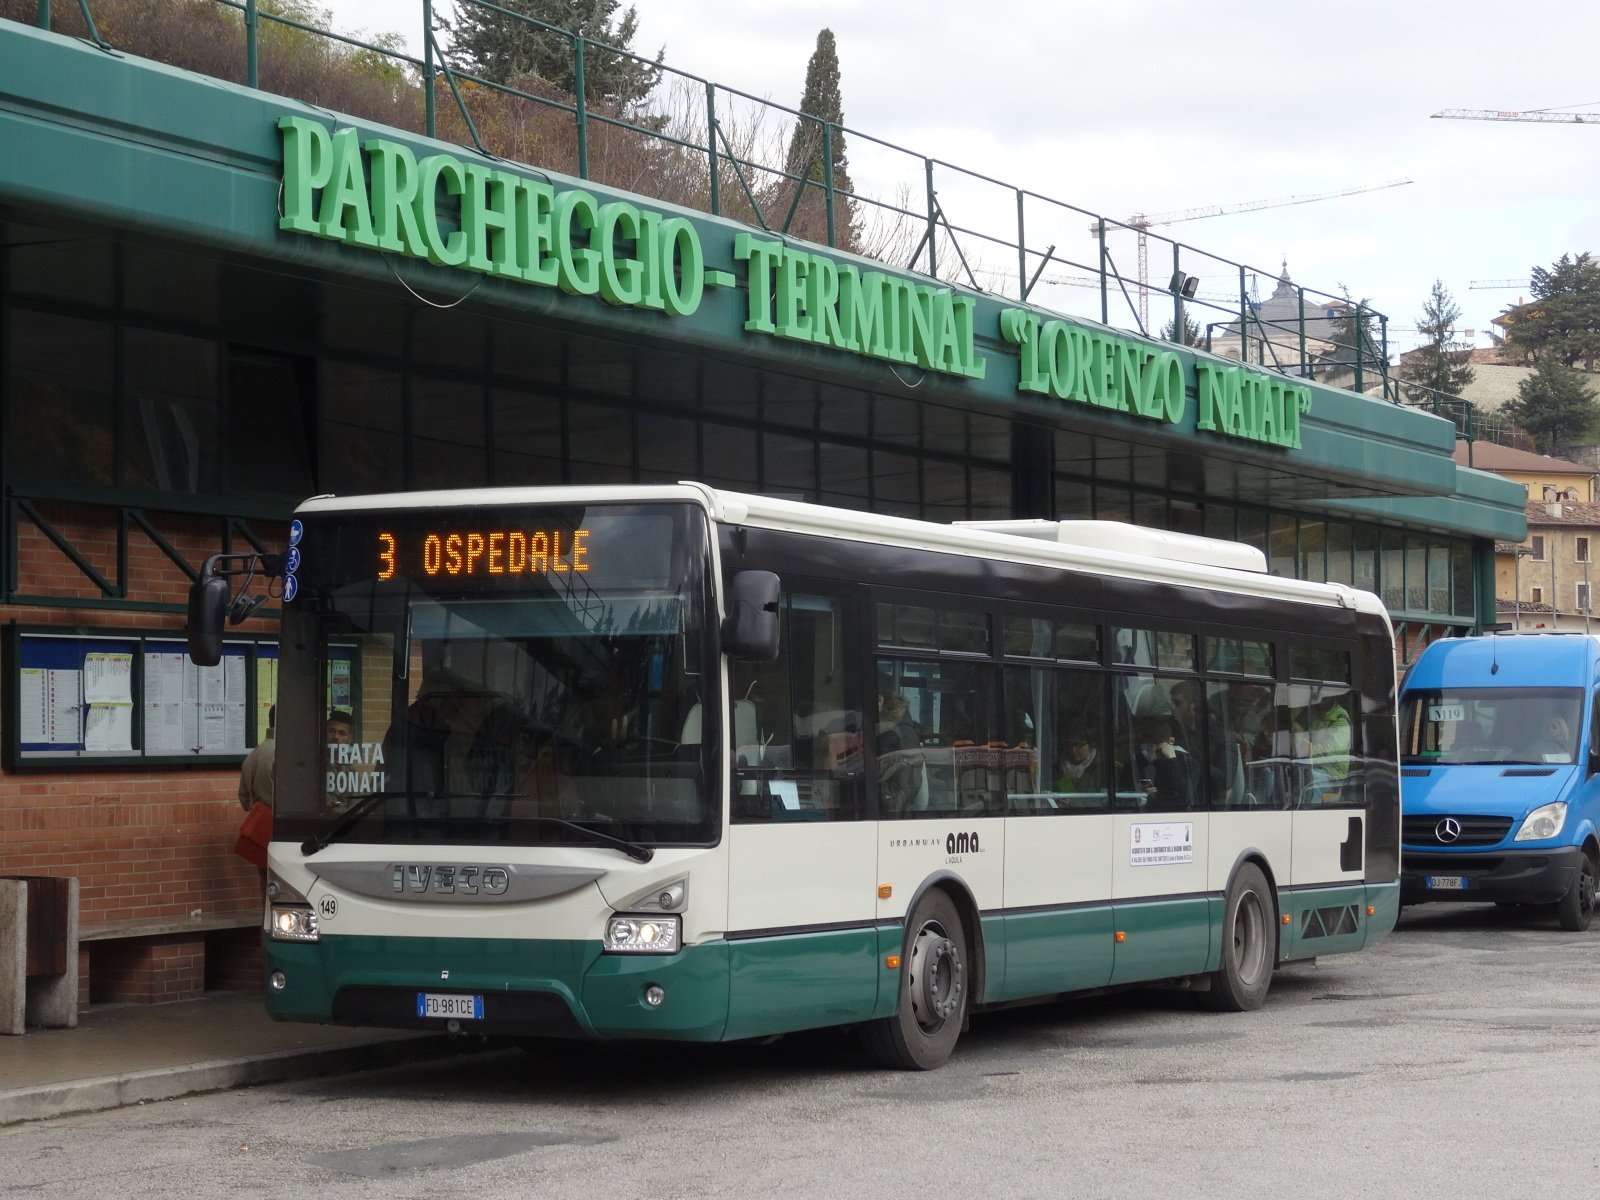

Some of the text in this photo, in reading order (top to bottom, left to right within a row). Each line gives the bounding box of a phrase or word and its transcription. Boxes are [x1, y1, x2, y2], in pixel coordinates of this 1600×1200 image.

[734, 232, 986, 380] TERMINAL
[378, 530, 590, 580] 3 OSPEDALE
[327, 743, 385, 765] TRATA
[326, 771, 385, 793] BONATI
[945, 831, 979, 855] ama
[392, 864, 510, 896] IVECO
[319, 900, 336, 915] 149
